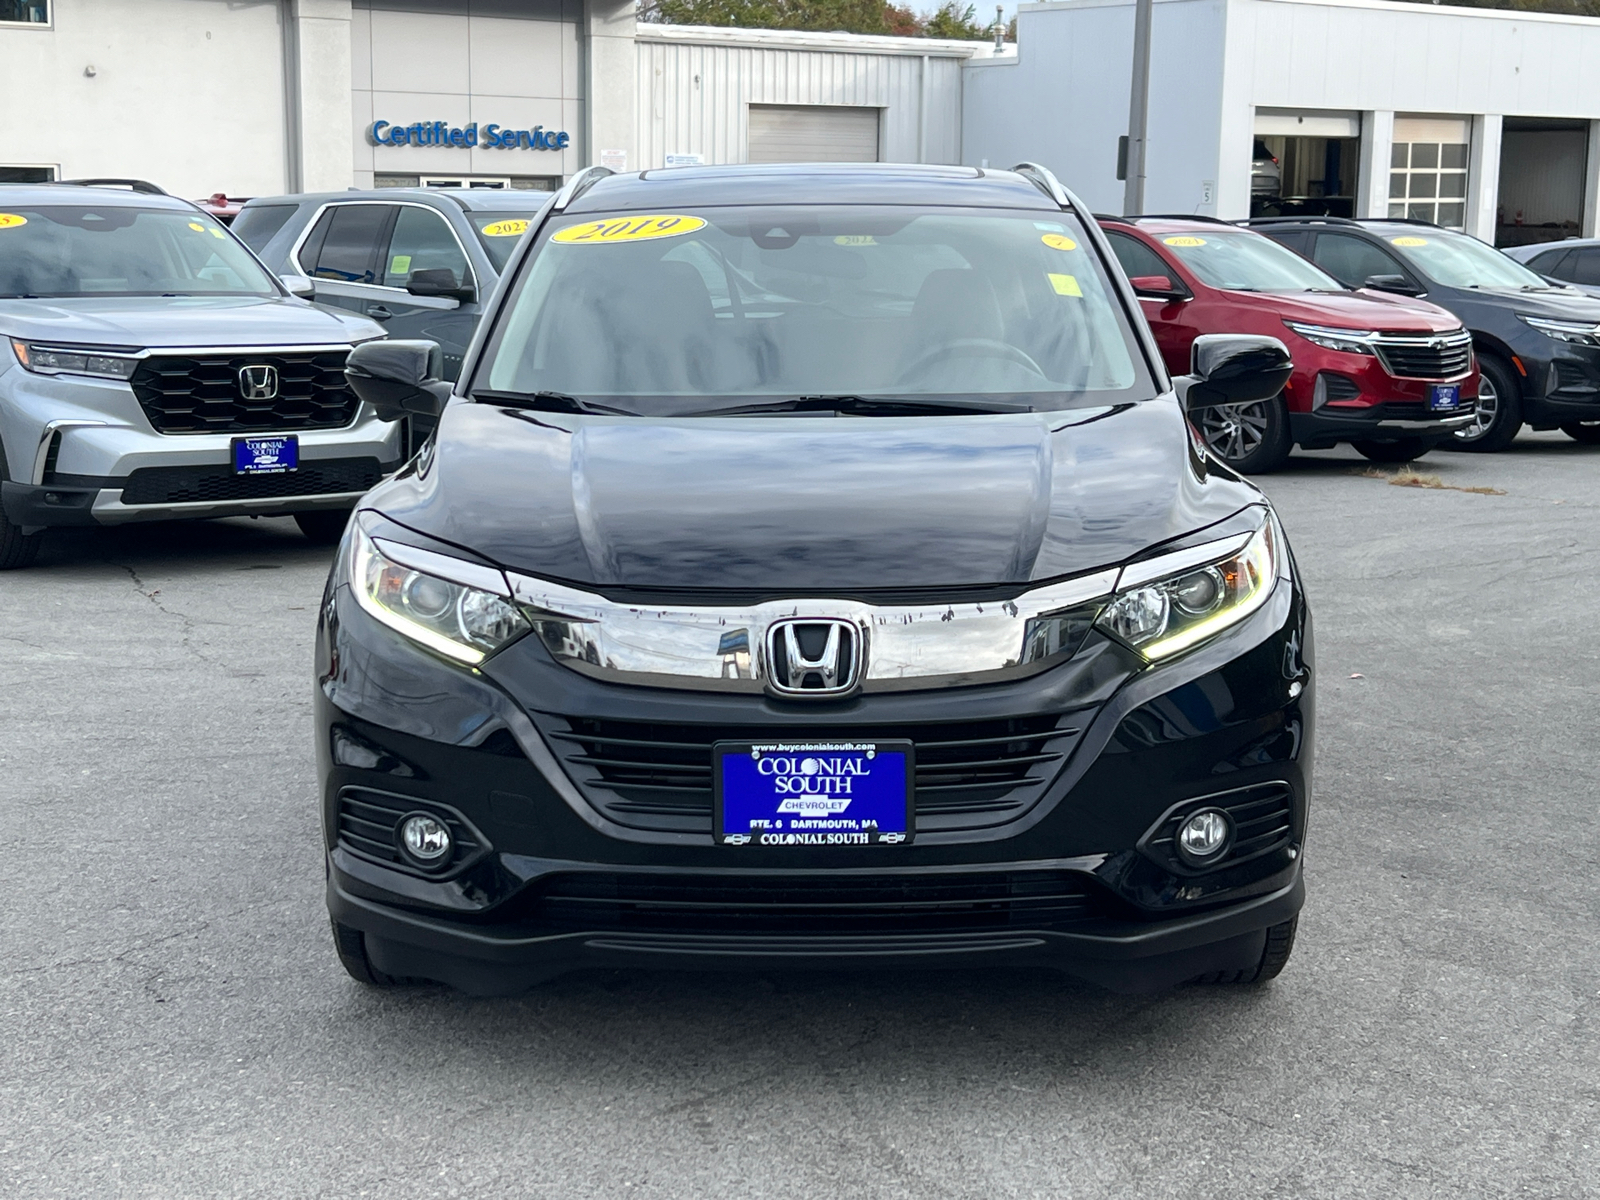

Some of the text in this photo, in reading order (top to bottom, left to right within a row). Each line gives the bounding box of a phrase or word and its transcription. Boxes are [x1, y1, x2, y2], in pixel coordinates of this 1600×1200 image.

[373, 120, 570, 148] Certified Service
[1204, 192, 1210, 202] 5
[572, 218, 682, 240] 2019
[751, 742, 876, 753] www.buycolonialsouth.com
[758, 757, 871, 776] COLONIAL
[775, 776, 853, 794] SOUTH
[785, 801, 844, 810] CHEVROLET
[750, 819, 878, 829] RTE. 6 DARTMOUTH, MA
[760, 833, 869, 845] COLONIAL SOUTH
